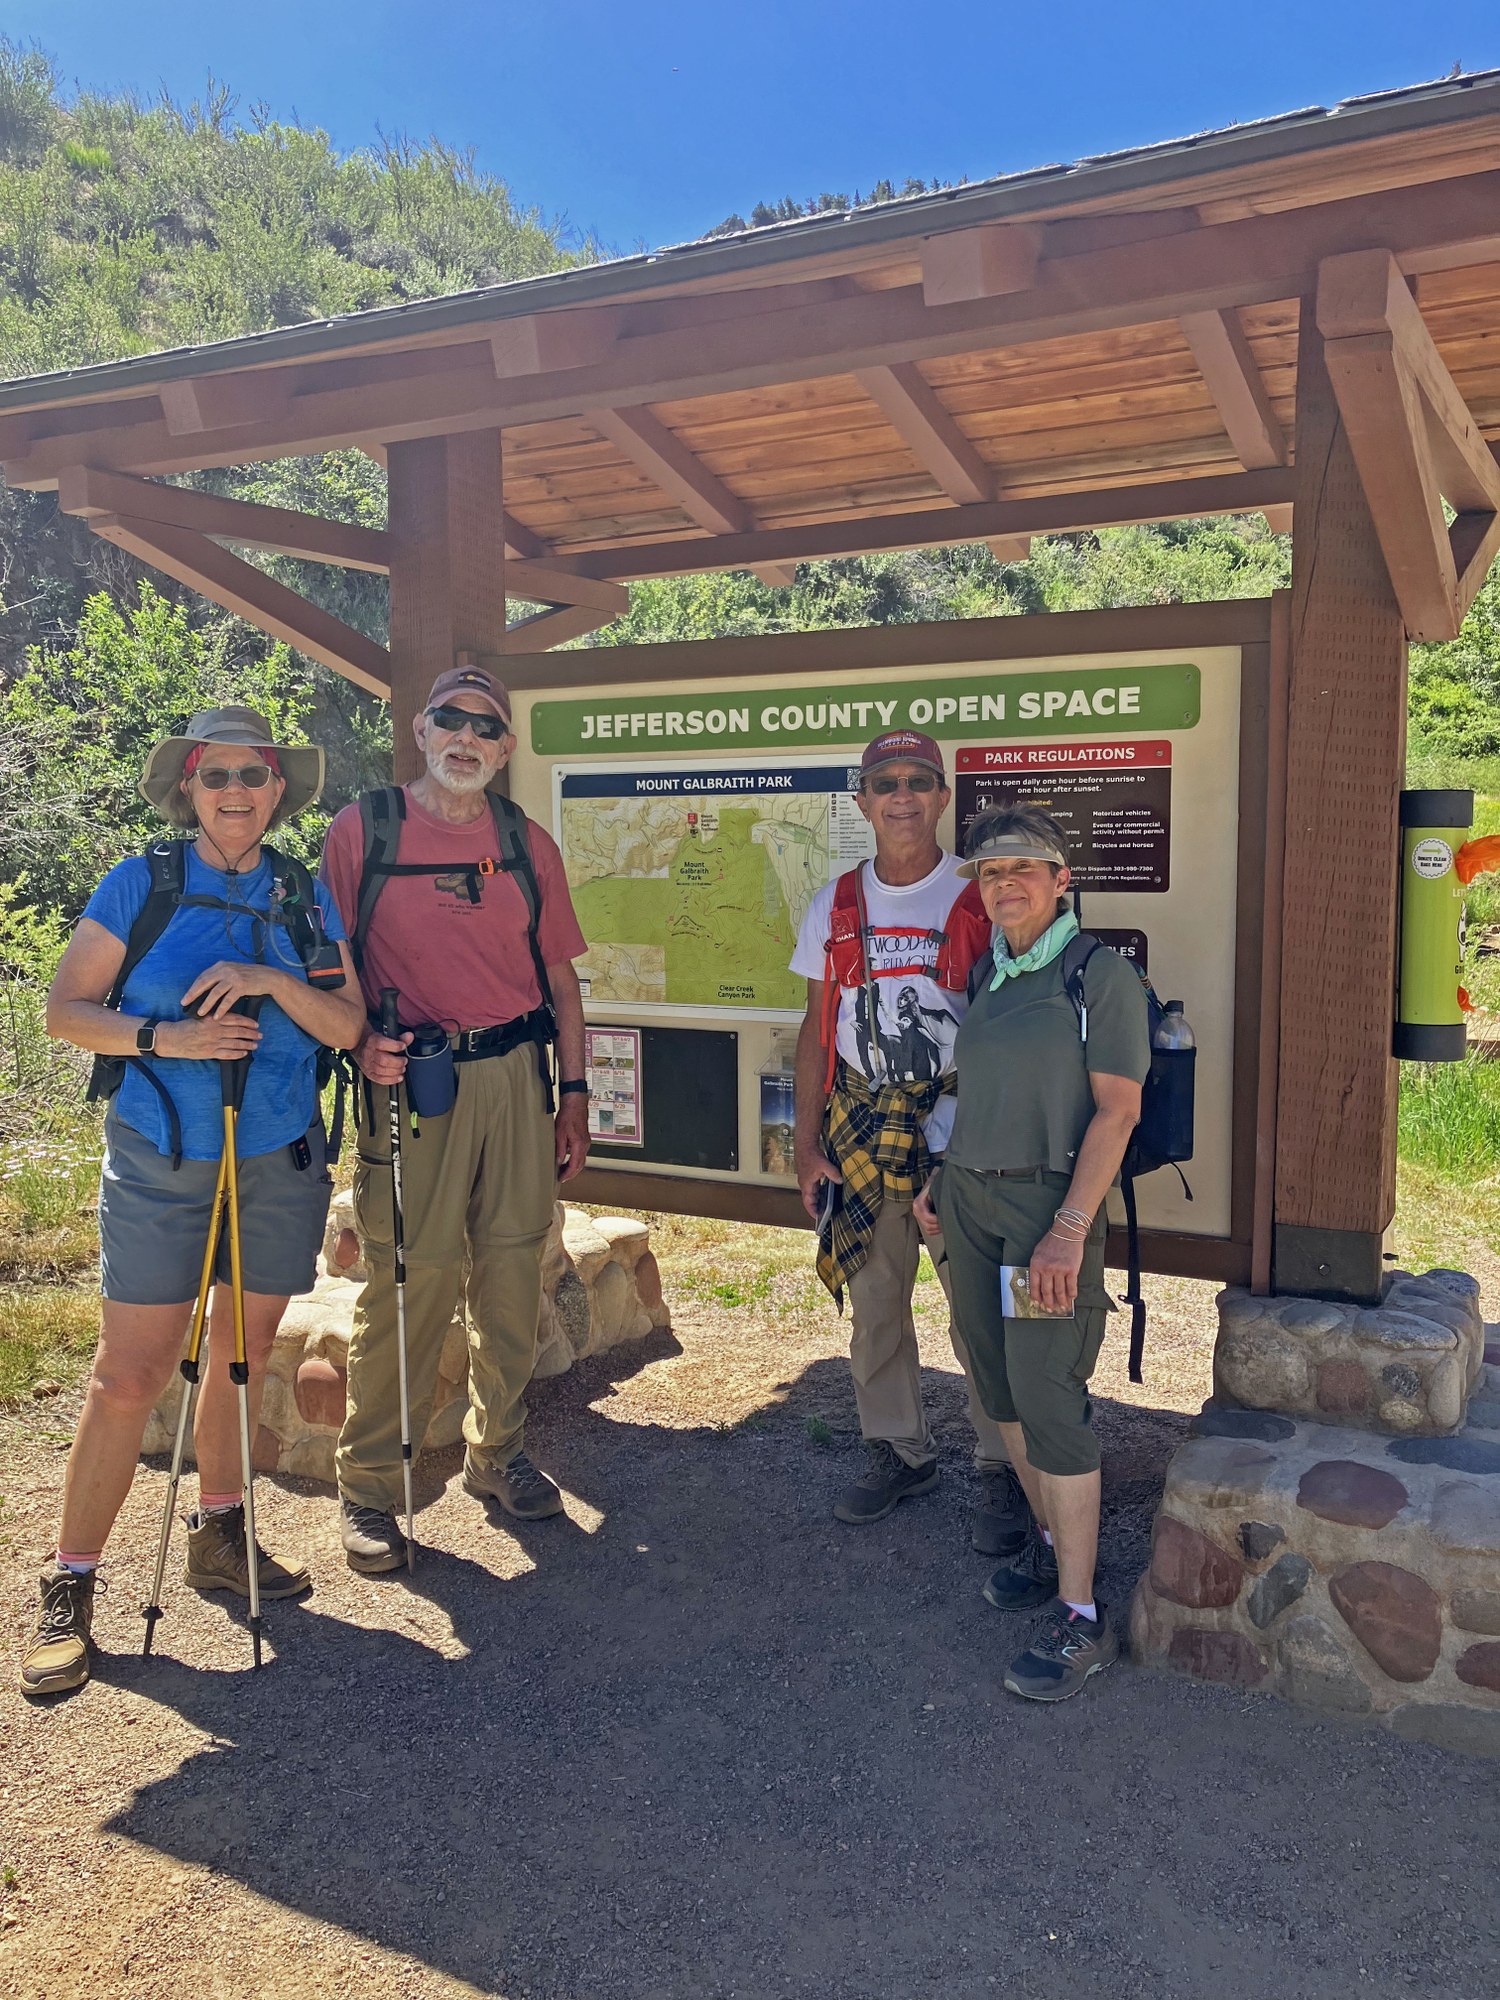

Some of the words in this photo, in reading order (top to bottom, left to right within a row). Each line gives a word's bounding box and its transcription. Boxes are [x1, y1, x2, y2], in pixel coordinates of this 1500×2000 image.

[581, 708, 749, 739] JEFFERSON
[760, 700, 898, 732] COUNTY
[908, 694, 1005, 725] OPEN
[1018, 686, 1141, 719] SPACE
[985, 751, 1024, 764] PARK
[1028, 747, 1135, 763] REGULATIONS
[636, 779, 680, 791] MOUNT
[682, 777, 754, 790] GALBRAITH
[758, 775, 793, 788] PARK
[975, 779, 992, 787] Park
[1002, 779, 1020, 788] open
[1022, 778, 1041, 787] daily
[1079, 776, 1104, 784] before
[1106, 775, 1135, 783] sunrise
[1143, 828, 1165, 836] permit
[835, 932, 855, 943] THAN
[883, 955, 937, 970] RUMOUR
[717, 991, 740, 1000] Canyon
[389, 1100, 400, 1145] LEKI
